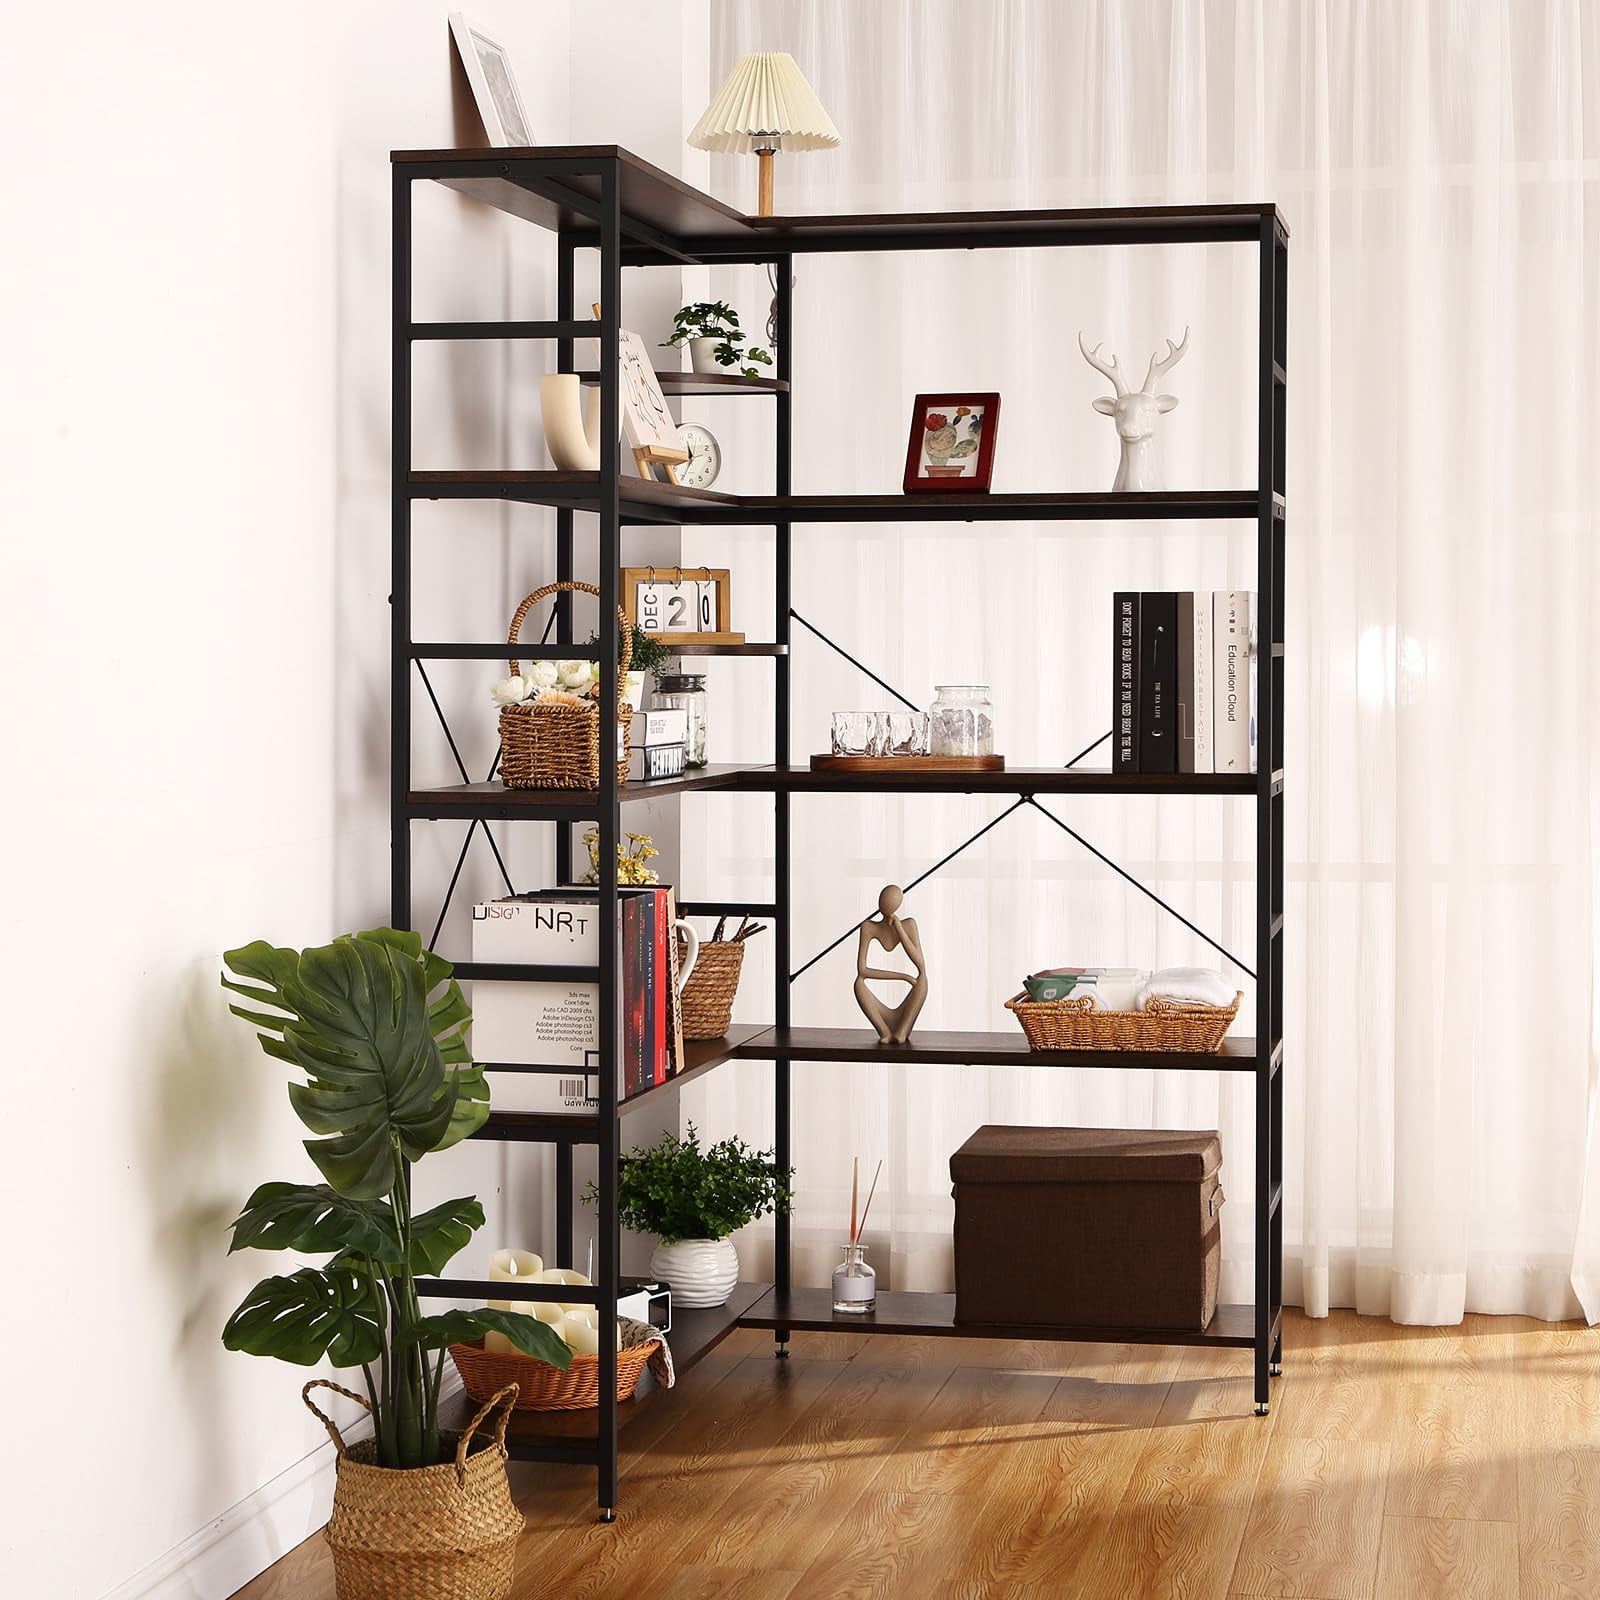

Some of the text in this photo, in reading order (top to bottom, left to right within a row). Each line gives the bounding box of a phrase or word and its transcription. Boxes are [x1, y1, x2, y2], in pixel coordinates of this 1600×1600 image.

[643, 594, 658, 629] DEC
[1121, 617, 1132, 636] FORGET
[1121, 639, 1132, 647] TO
[1121, 648, 1132, 662] READ
[1121, 663, 1132, 680] BOOKS
[1227, 645, 1237, 722] Education Cloud
[1121, 691, 1132, 701] YOU
[1121, 702, 1132, 717] NEED
[1121, 736, 1132, 747] THE
[650, 747, 683, 777] CENTURY
